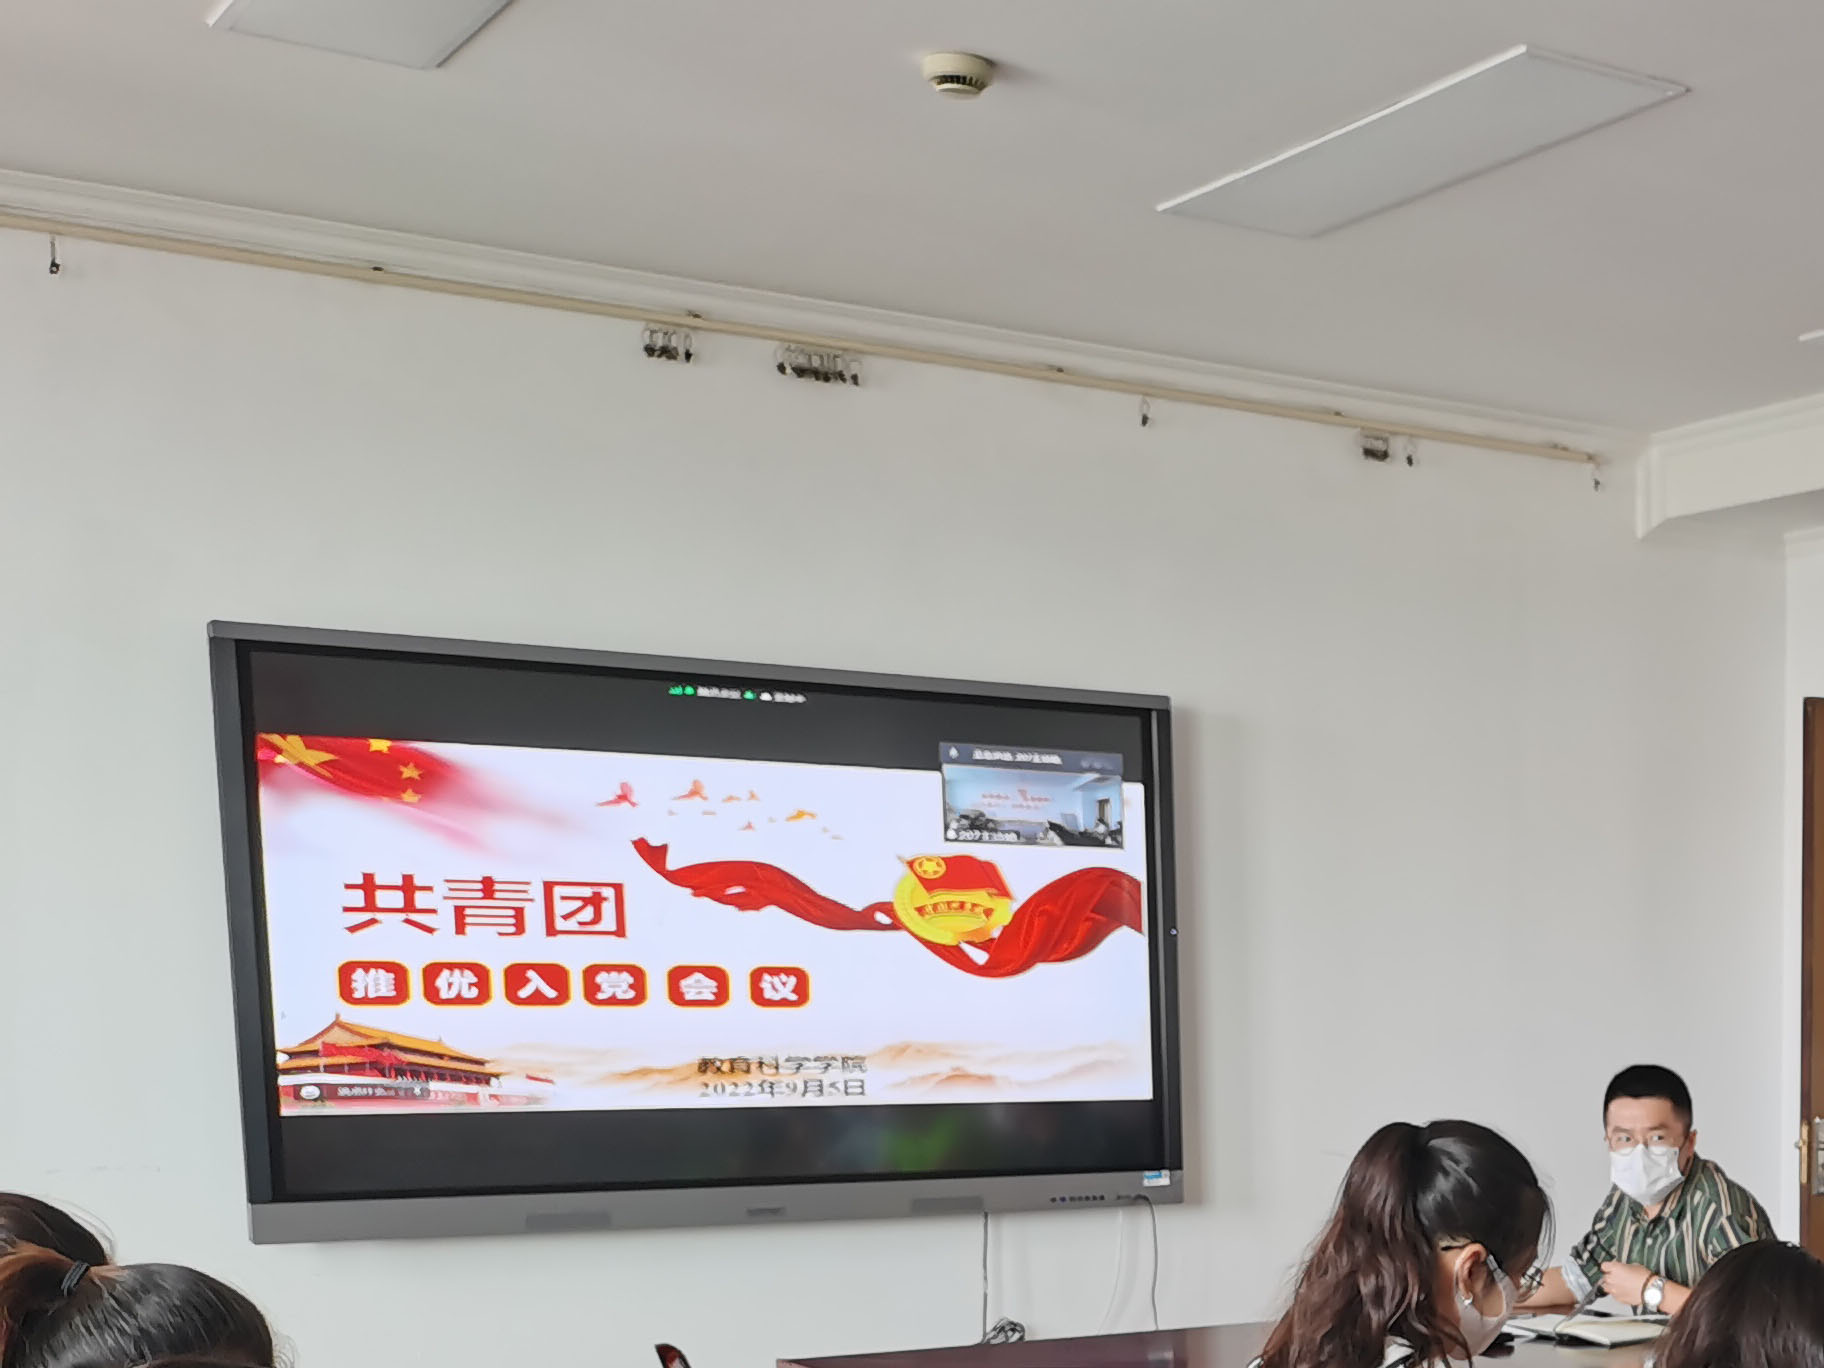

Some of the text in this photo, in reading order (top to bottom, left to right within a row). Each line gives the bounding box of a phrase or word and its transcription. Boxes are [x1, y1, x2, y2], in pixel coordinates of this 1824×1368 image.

[342, 871, 628, 939] 共青团
[350, 966, 799, 1001] 推优入党会议
[697, 1055, 867, 1075] 教育科学学院
[699, 1078, 866, 1098] 2022年9月5日
